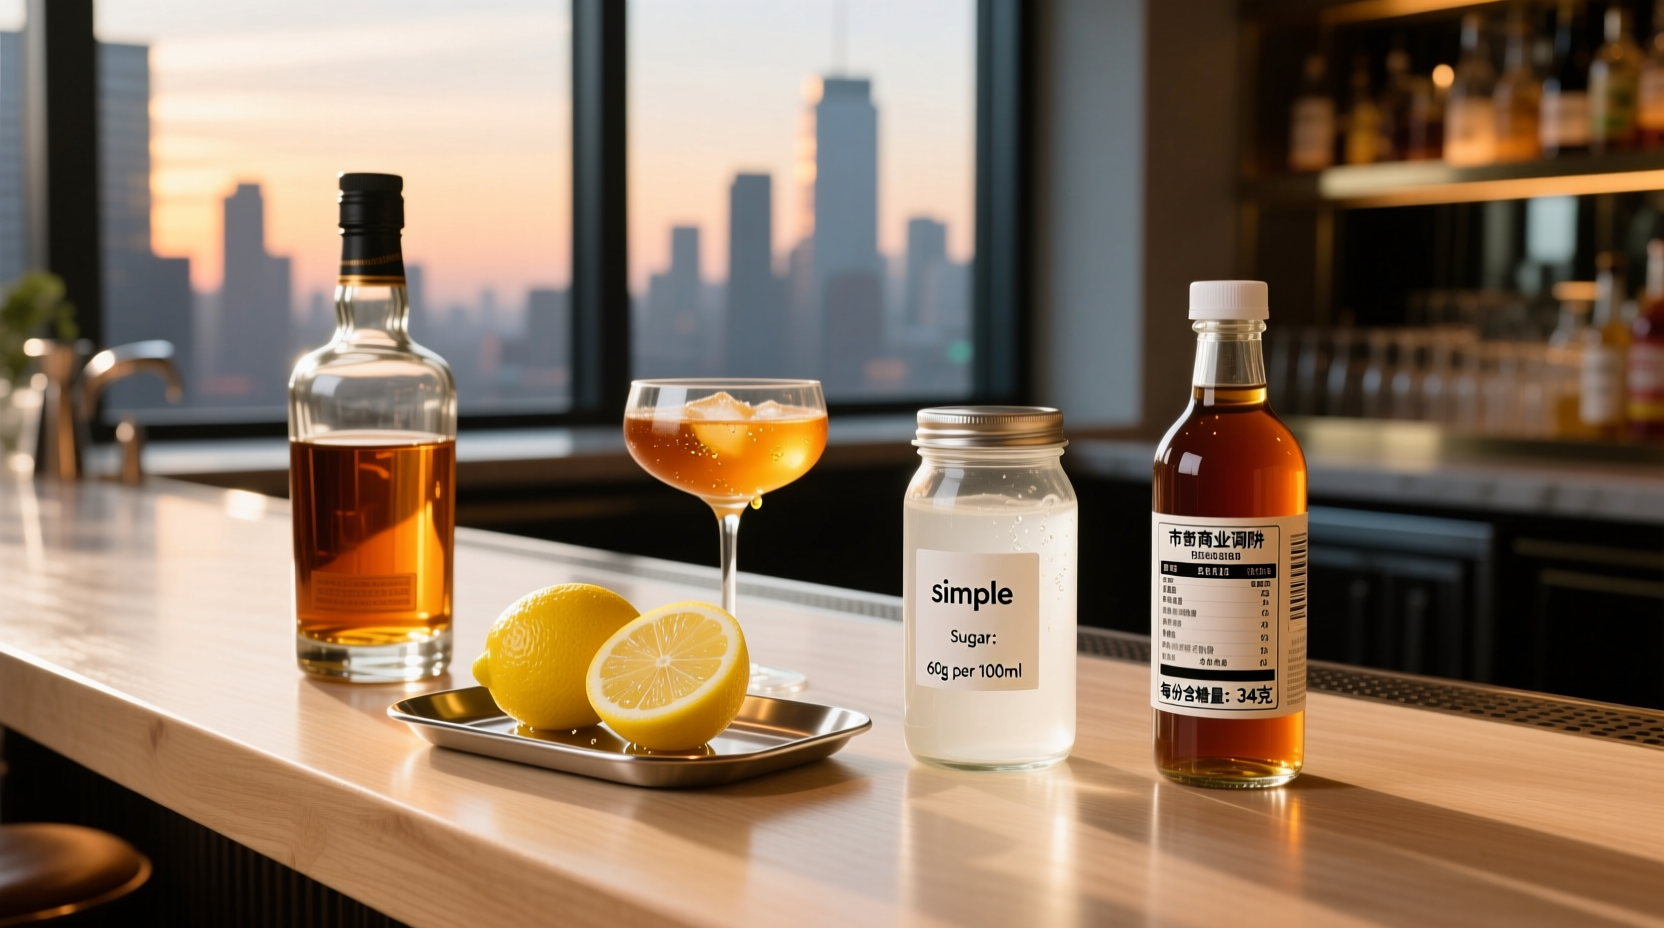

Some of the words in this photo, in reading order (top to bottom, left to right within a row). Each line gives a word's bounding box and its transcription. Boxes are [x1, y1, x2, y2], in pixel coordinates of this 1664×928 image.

[931, 579, 1013, 611] simple
[950, 629, 996, 648] Sugar:
[927, 661, 948, 681] 60g
[952, 666, 975, 680] per
[979, 662, 1022, 678] 100ml
